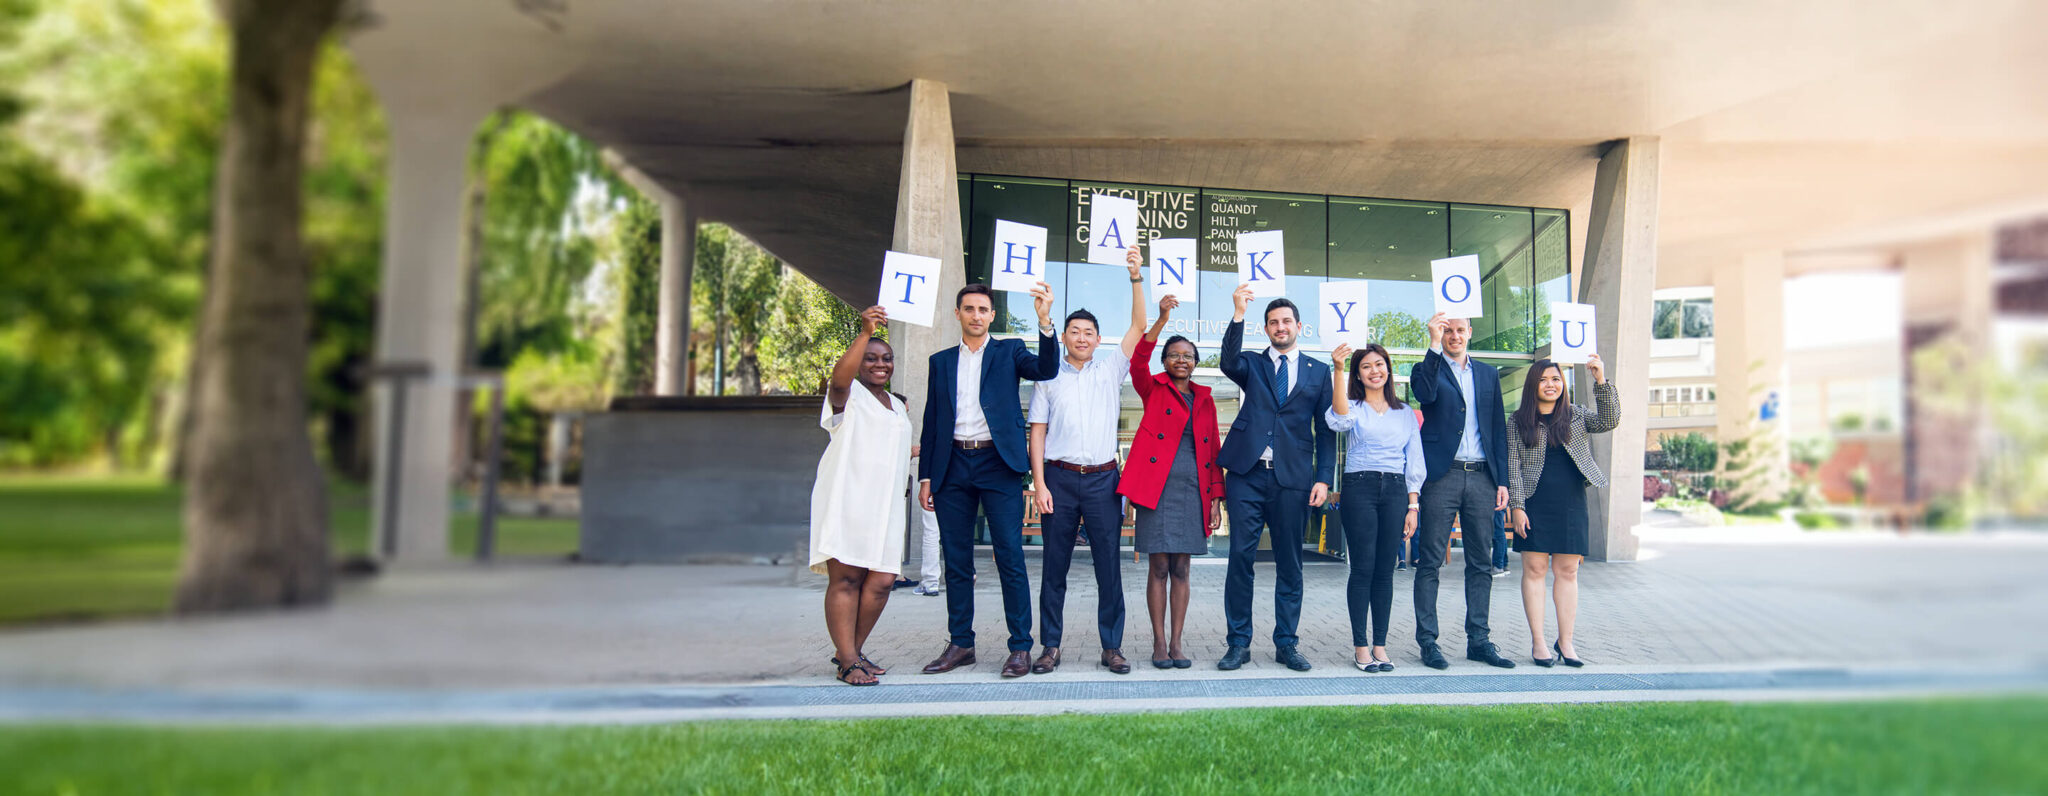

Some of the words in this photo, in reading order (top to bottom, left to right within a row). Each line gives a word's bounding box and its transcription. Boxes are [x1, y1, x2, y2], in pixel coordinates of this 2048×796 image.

[1077, 206, 1187, 229] LNING
[1211, 203, 1258, 215] QUANDT
[1211, 216, 1239, 227] HILTI
[1076, 226, 1162, 246] CER
[1097, 218, 1127, 249] A
[1211, 229, 1257, 239] PANA
[1211, 242, 1238, 253] MOL
[1001, 241, 1037, 276] H
[1157, 257, 1188, 285] N
[1247, 251, 1276, 281] K
[894, 271, 926, 305] T
[1441, 274, 1472, 303] O
[1147, 317, 1230, 335] EECUTIVE
[1328, 301, 1357, 333] Y
[1559, 319, 1588, 348] U
